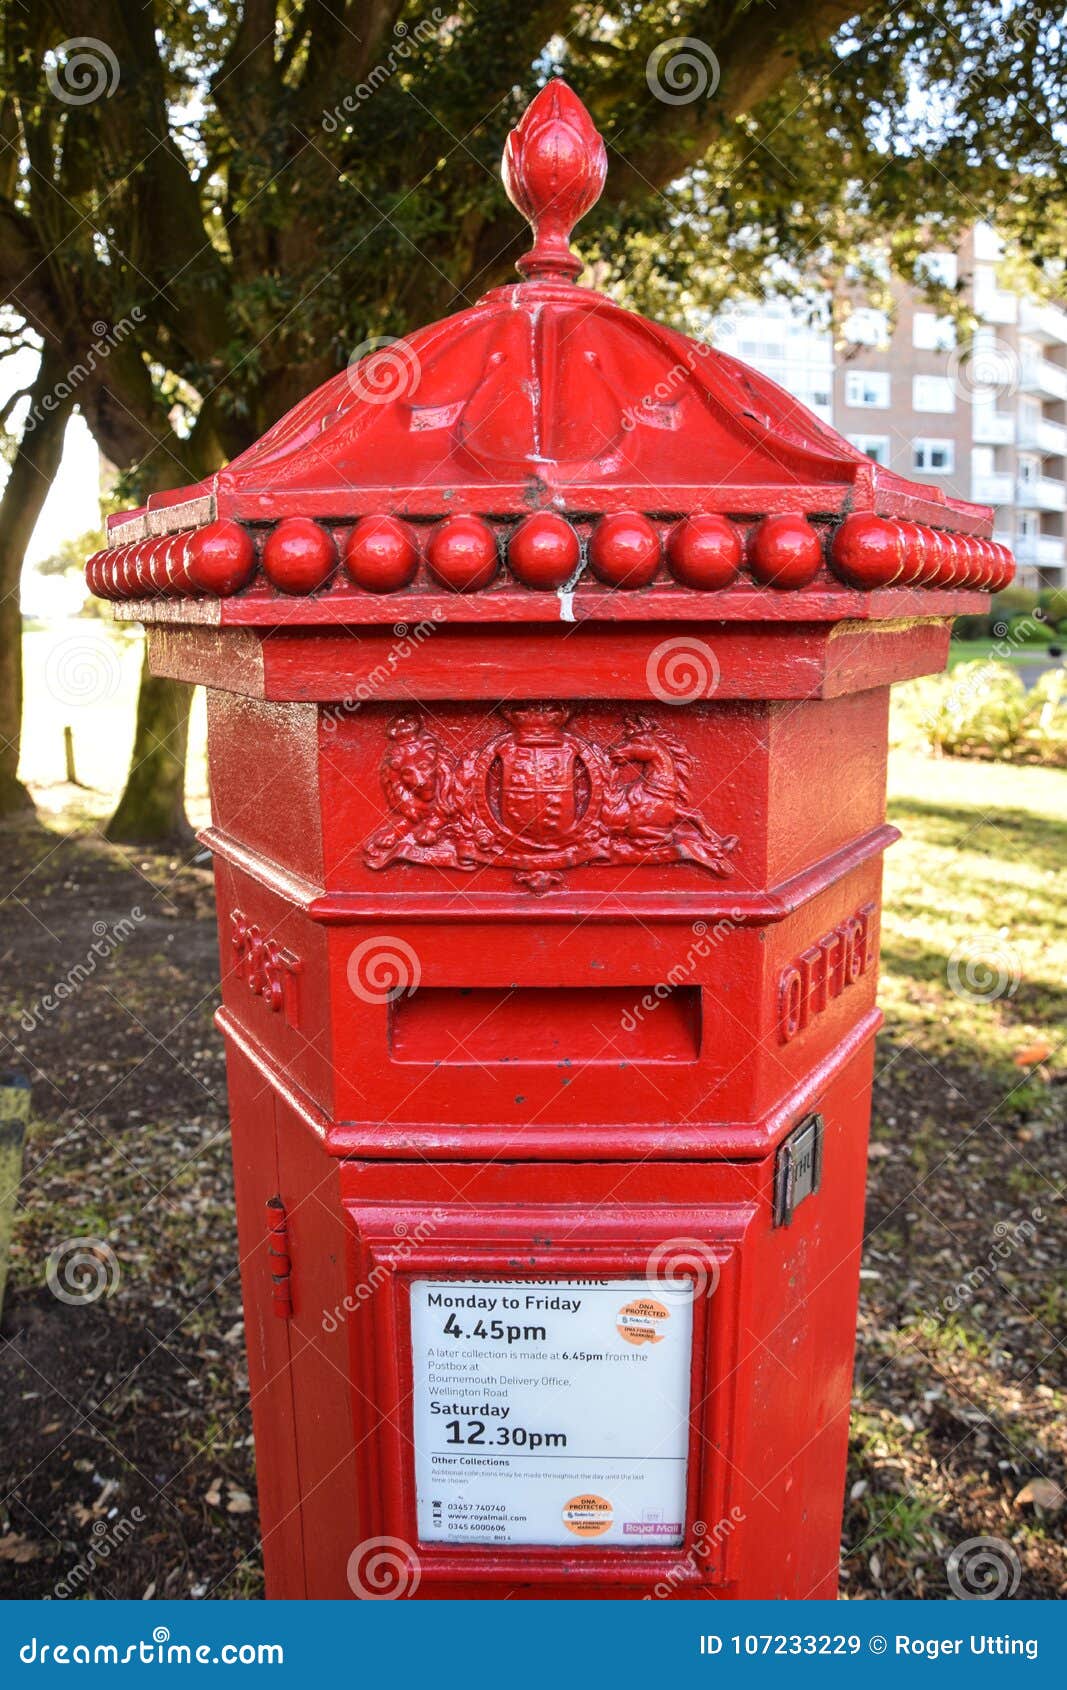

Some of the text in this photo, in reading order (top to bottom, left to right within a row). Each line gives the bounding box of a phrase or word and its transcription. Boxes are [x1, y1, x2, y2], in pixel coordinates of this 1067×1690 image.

[229, 908, 301, 1028] POST
[777, 902, 876, 1046] OFFICE
[428, 1293, 581, 1313] Monday to Friday
[625, 1308, 666, 1318] PROTECTED
[443, 1313, 546, 1344] 4.45pm
[428, 1348, 648, 1362] A later collection is made at 6.45pm from the
[428, 1361, 479, 1371] Postbox at
[428, 1373, 497, 1384] Bournemouth
[500, 1375, 538, 1387] Delivery
[429, 1386, 508, 1398] Wellington Road
[430, 1401, 510, 1419] Saturday
[445, 1420, 567, 1450] 12.30pm
[431, 1456, 510, 1466] Other Collections
[447, 1503, 506, 1512] 03457 740740
[447, 1513, 527, 1522] www.royalmail.com
[470, 1523, 506, 1531] 6000606
[625, 1523, 679, 1534] Royal Mail
